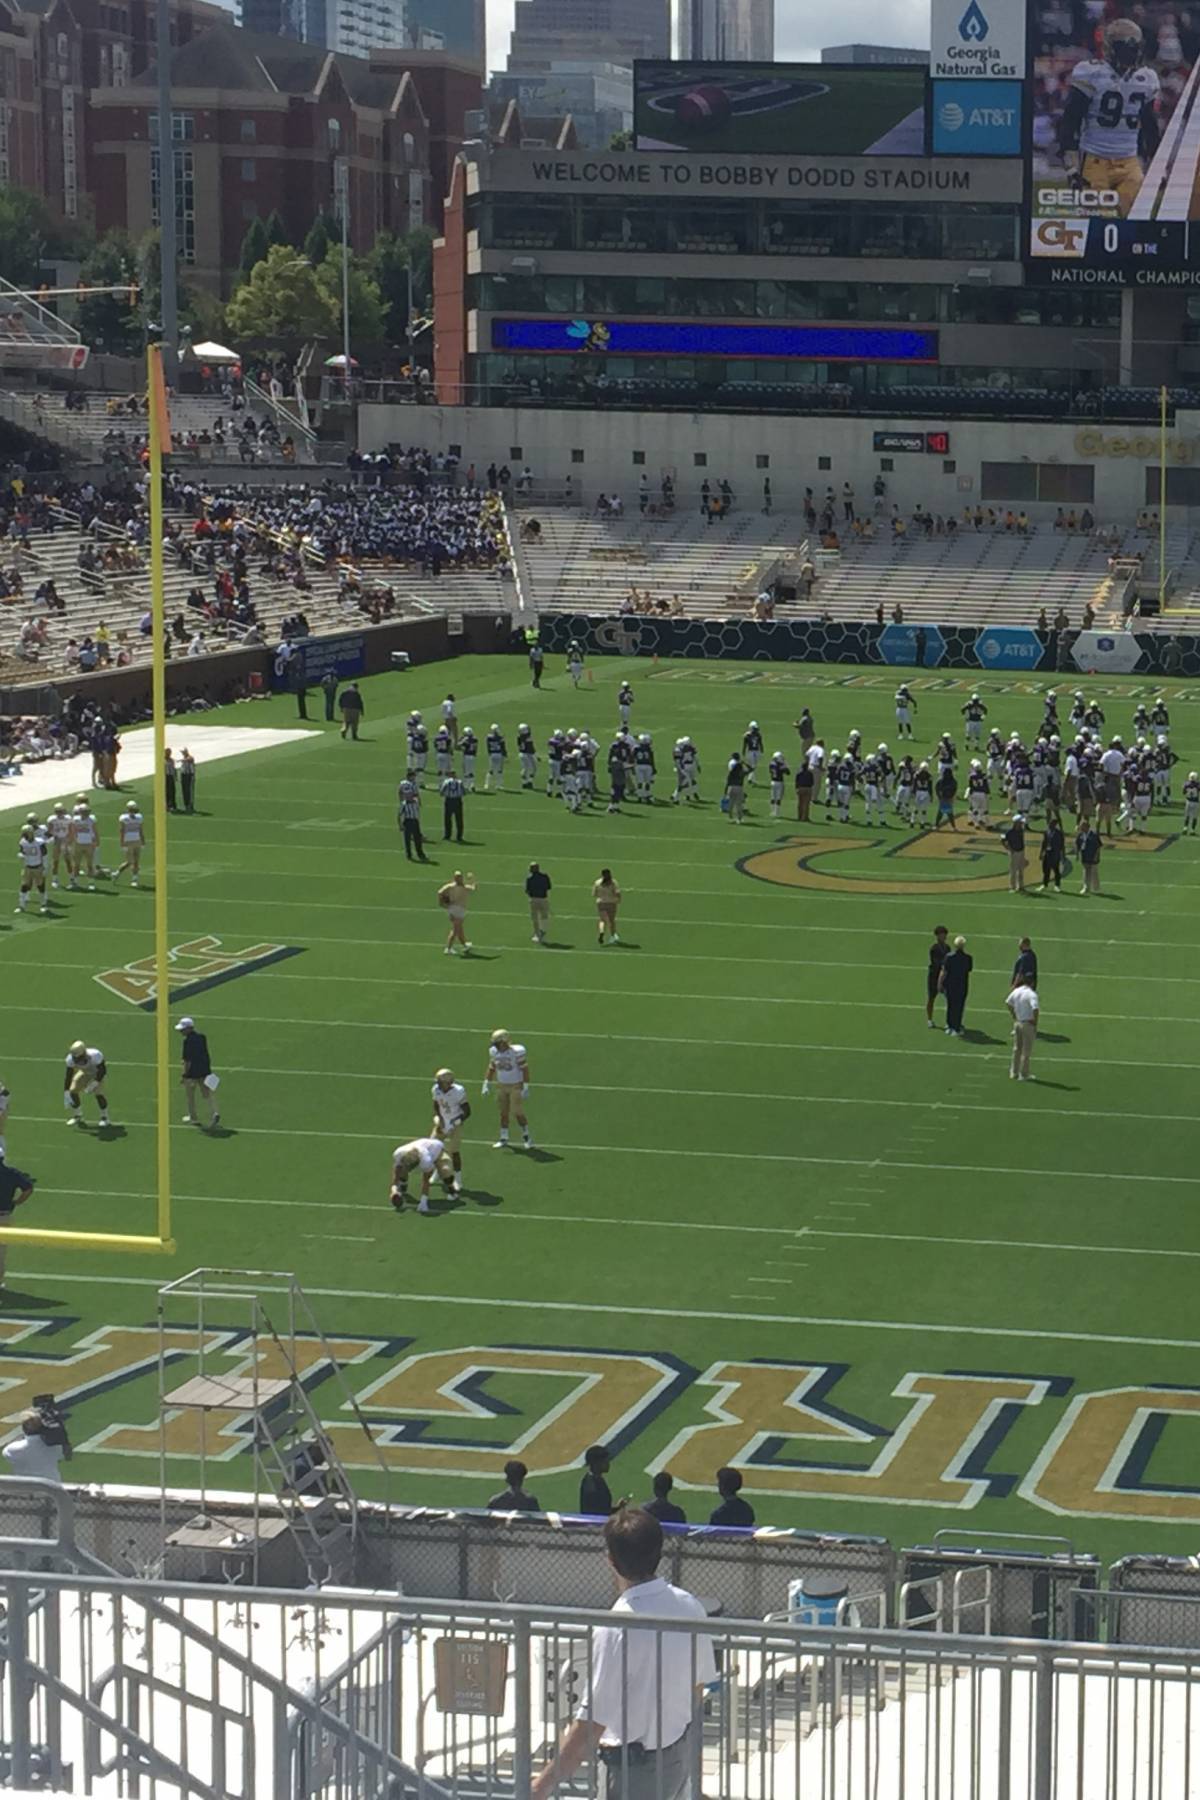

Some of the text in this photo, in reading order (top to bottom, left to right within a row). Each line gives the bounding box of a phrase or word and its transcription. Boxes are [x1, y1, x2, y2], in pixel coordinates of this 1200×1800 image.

[946, 46, 1001, 65] Georgia
[935, 61, 1017, 77] Natural Gas
[968, 107, 1017, 127] AT&T
[532, 162, 971, 191] WELCOME TO BOBBY DODD STADIUM
[1037, 188, 1120, 207] GEICO
[1037, 220, 1084, 252] GT
[1104, 223, 1119, 253] 0
[1051, 268, 1127, 284] NATIONAL
[1003, 643, 1038, 657] AT&T
